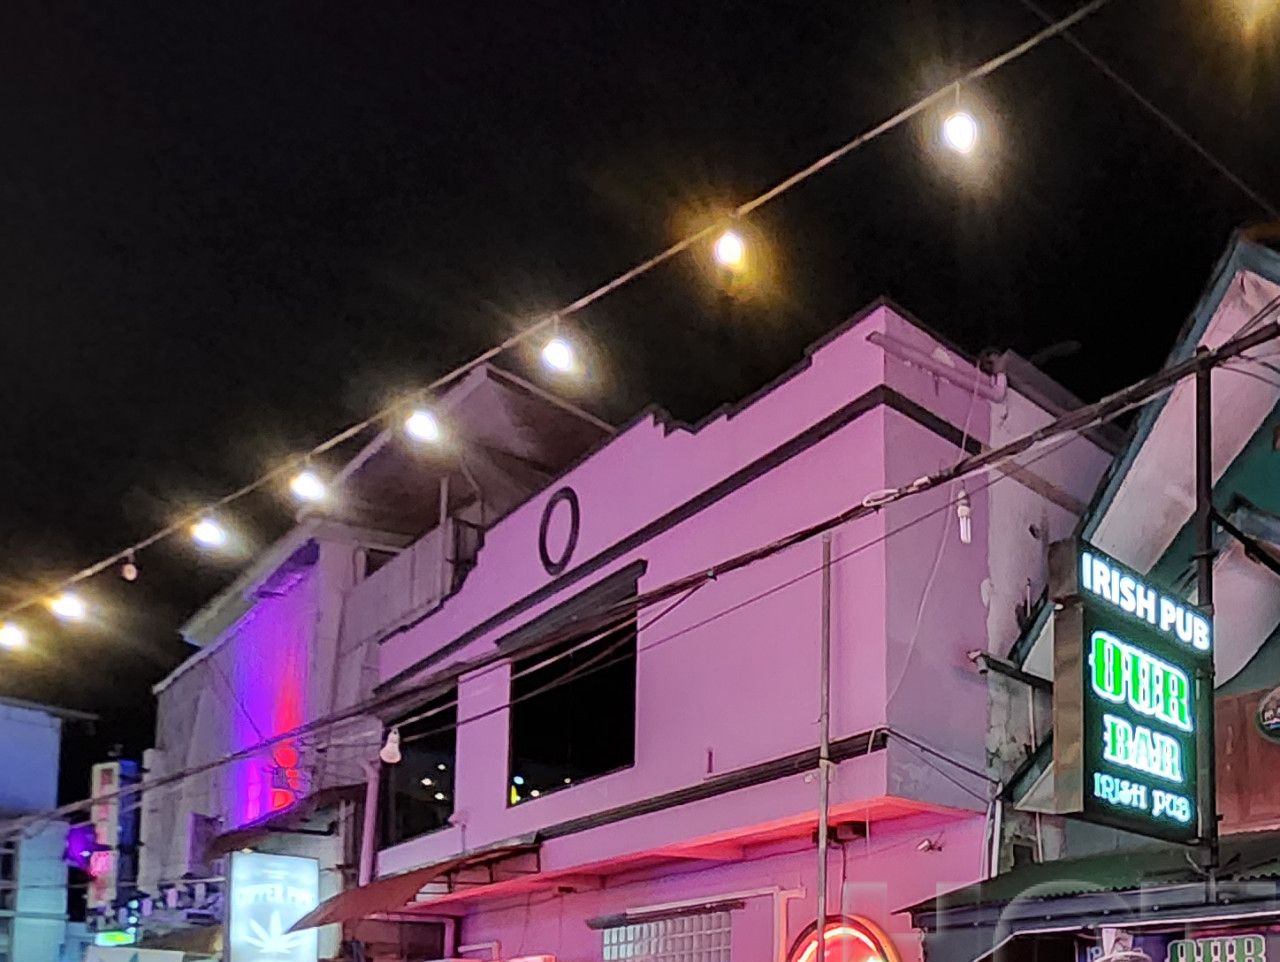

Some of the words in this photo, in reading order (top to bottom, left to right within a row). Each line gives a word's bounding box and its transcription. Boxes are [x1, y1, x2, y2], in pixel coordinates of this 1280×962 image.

[1081, 551, 1157, 625] IRISH
[1159, 595, 1211, 651] PUB
[1088, 630, 1194, 732] OUR
[1102, 713, 1184, 782] BAR
